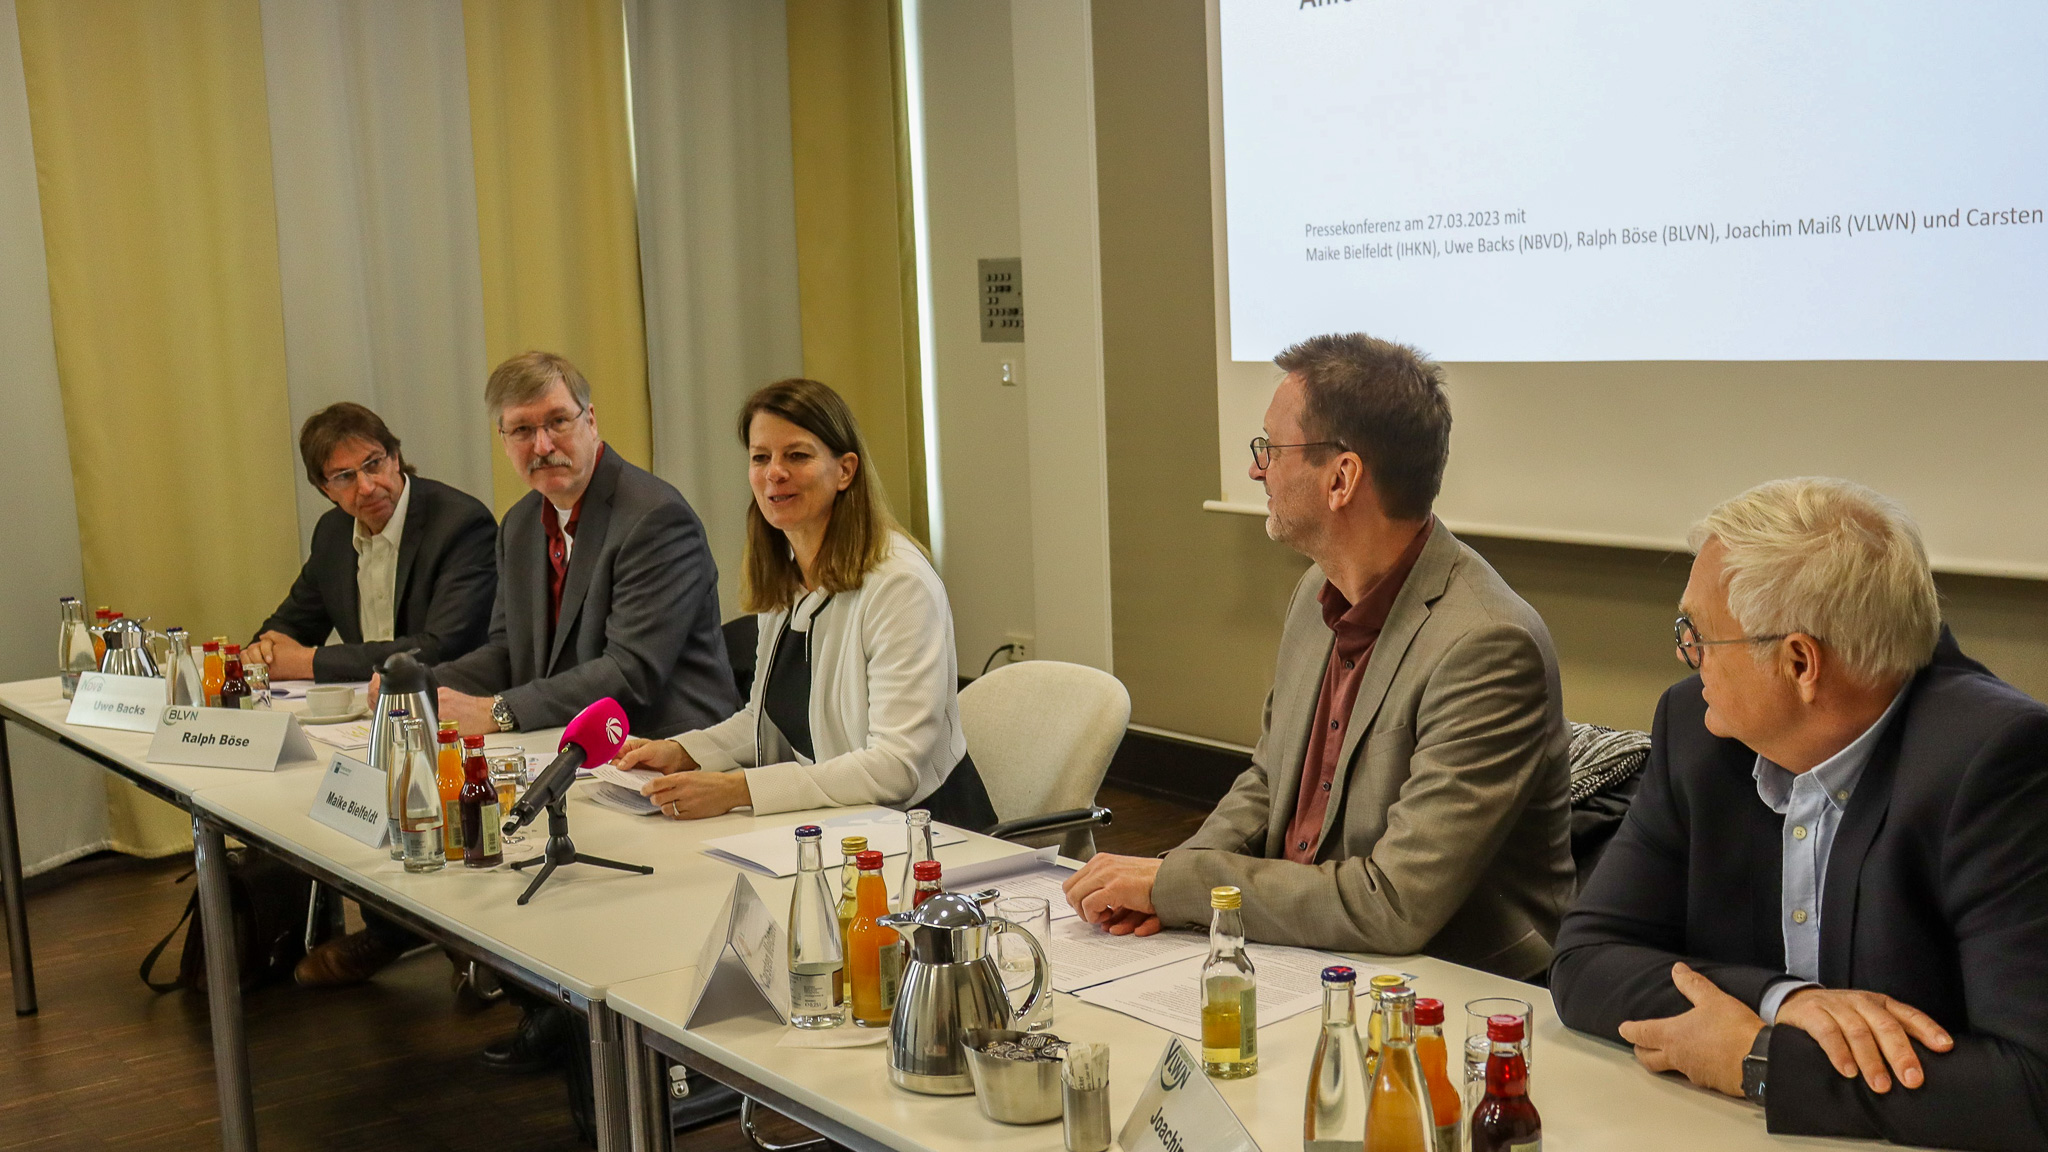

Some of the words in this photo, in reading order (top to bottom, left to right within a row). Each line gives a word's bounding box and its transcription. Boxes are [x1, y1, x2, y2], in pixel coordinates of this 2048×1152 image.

[1305, 218, 1401, 238] Pressekonferenz
[1404, 218, 1424, 232] am
[1427, 210, 1500, 230] 27.03.2023
[1504, 208, 1527, 225] mit
[1306, 245, 1341, 262] Maike
[1343, 241, 1393, 260] Bielfeldt
[1396, 239, 1441, 259] (IHKN),
[1444, 239, 1474, 255] Uwe
[1477, 236, 1516, 253] Backs
[1518, 231, 1573, 255] (NBVD),
[1577, 228, 1617, 250] Ralph
[1621, 226, 1658, 245] Böse
[1662, 223, 1720, 247] (BLVN),
[1724, 219, 1792, 240] Joachim
[1798, 214, 1842, 236] Maiß
[1847, 210, 1916, 238] (VLWN)
[1923, 207, 1960, 229] und
[1966, 206, 2044, 227] Carsten
[93, 700, 115, 712] Uwe
[116, 702, 146, 716] Backs
[168, 709, 199, 721] BLVN
[181, 731, 216, 747] Ralph
[218, 734, 250, 747] Böse
[325, 791, 348, 811] Maike
[346, 800, 379, 825] Bielfeldt
[1163, 1038, 1192, 1090] VLWN
